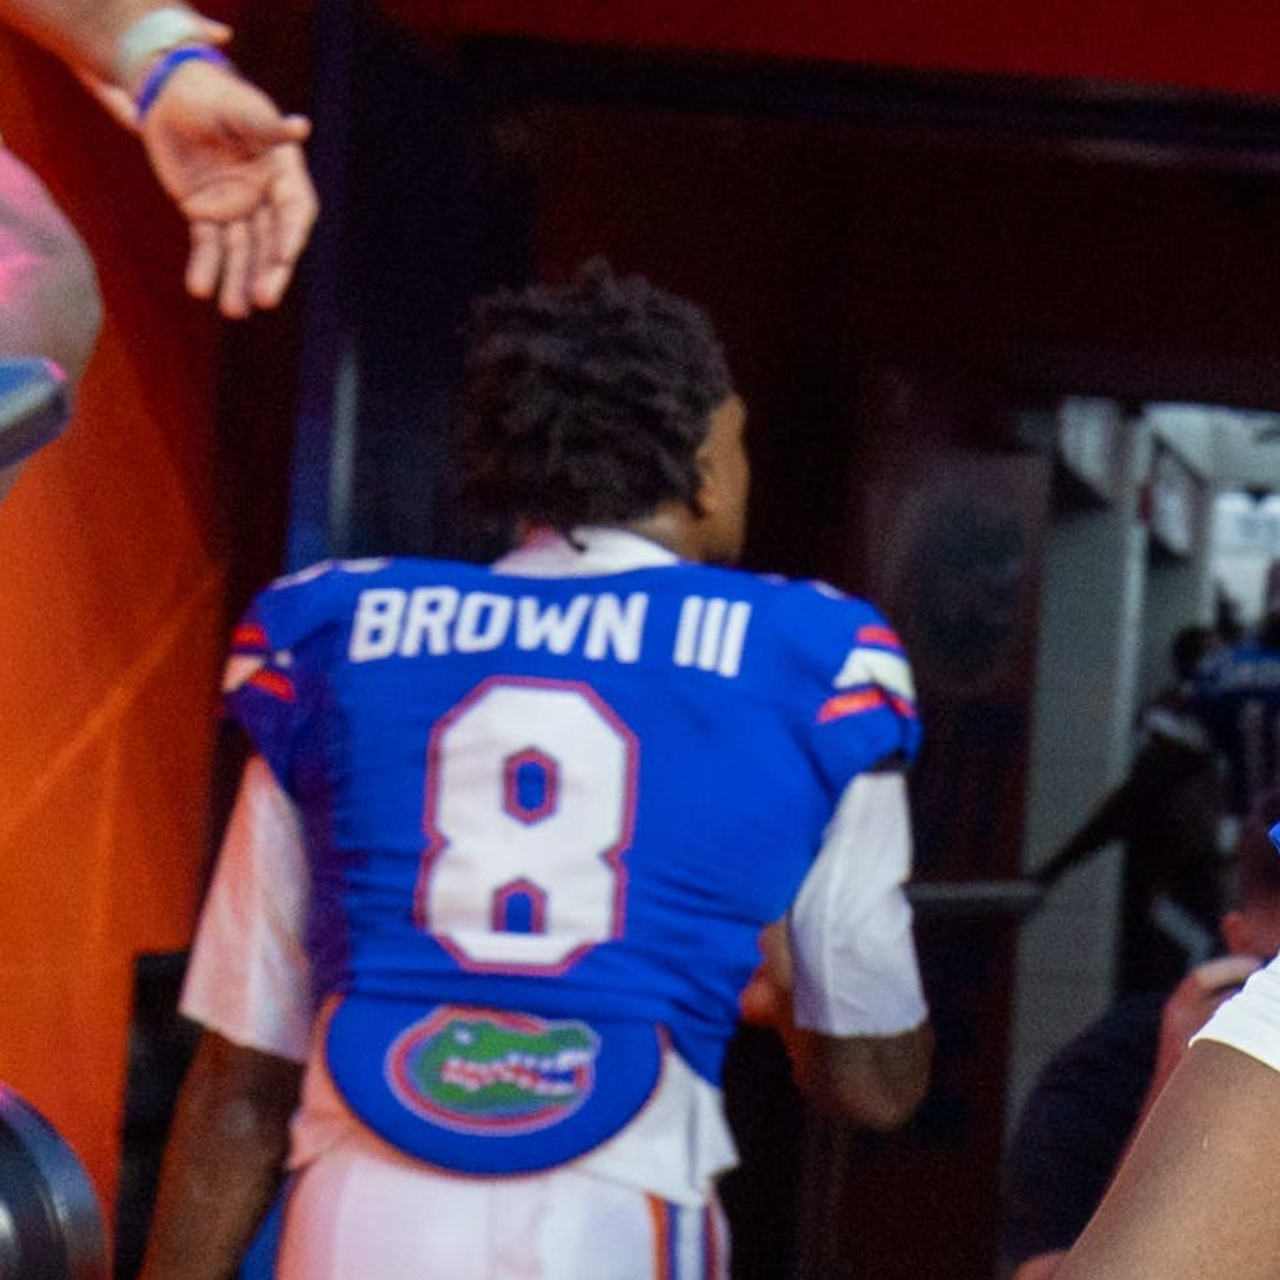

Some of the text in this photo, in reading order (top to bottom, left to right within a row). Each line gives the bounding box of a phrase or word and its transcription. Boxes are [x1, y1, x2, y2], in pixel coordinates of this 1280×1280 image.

[350, 586, 753, 679] BROWN III
[413, 677, 639, 975] 8
